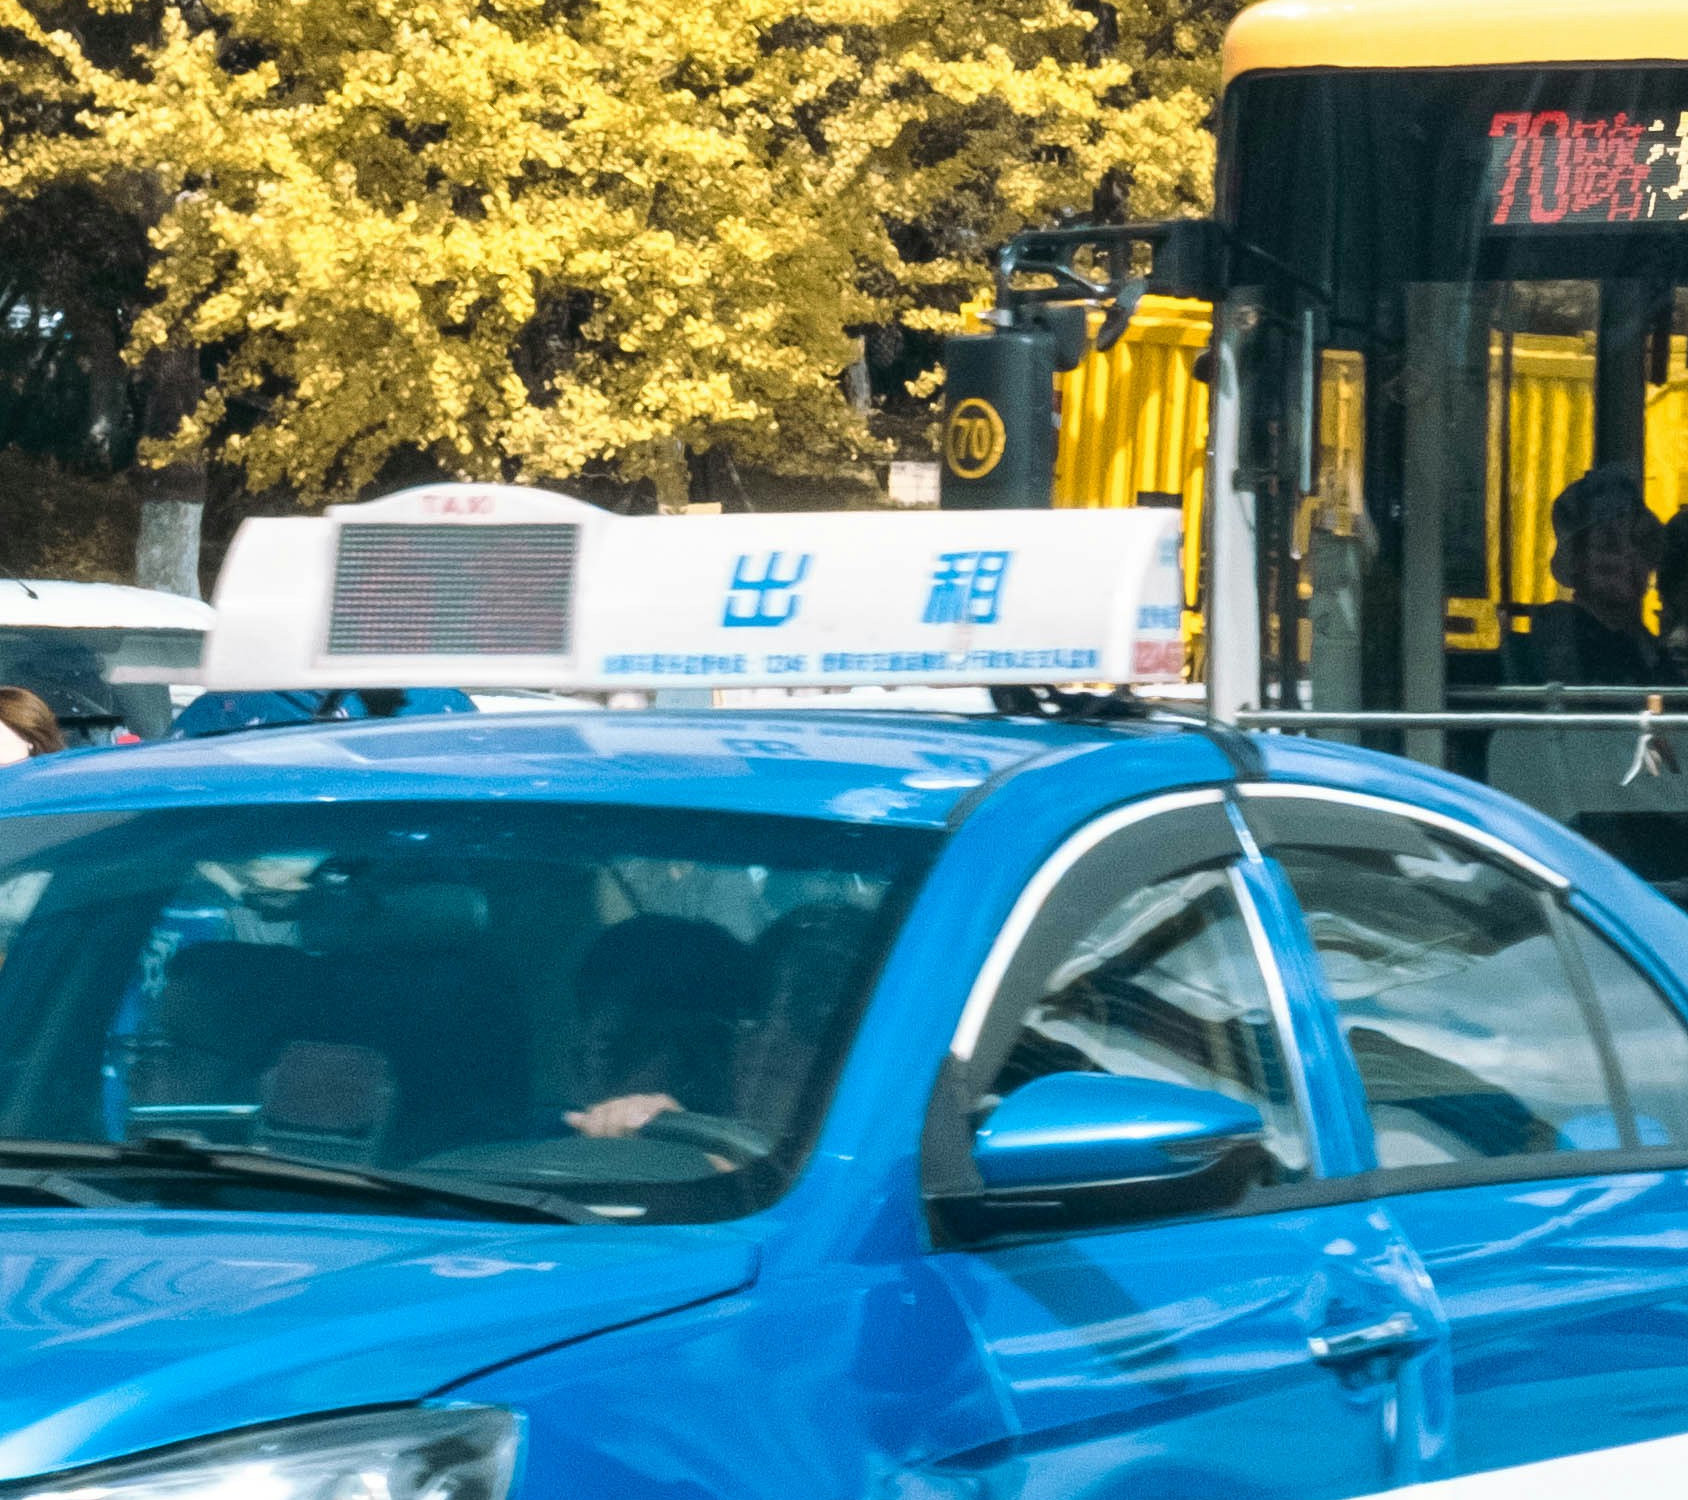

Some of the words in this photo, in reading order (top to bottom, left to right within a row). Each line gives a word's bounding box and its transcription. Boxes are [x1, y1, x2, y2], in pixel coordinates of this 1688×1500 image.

[1488, 110, 1651, 225] 70路
[953, 417, 990, 460] 70
[721, 551, 1013, 628] 出租
